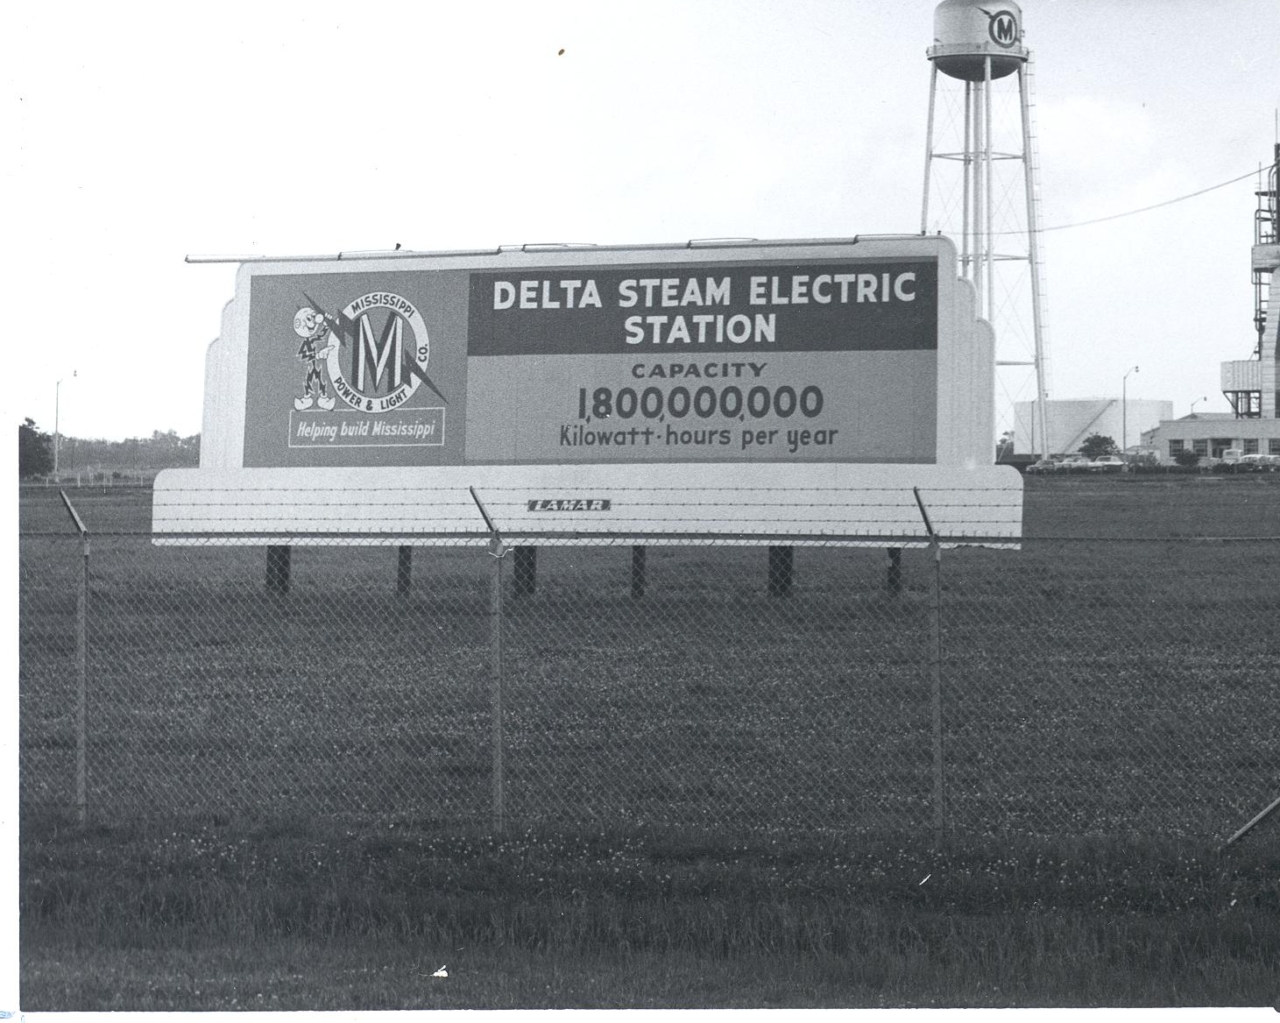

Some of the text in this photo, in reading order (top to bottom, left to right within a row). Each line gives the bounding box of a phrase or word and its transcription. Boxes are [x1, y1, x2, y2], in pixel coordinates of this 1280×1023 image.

[493, 272, 917, 310] DELTA STEAM ELECTRIC
[625, 313, 776, 344] STATION
[334, 294, 428, 411] MISSISSIPPI POWER & LIGHT CO.
[631, 362, 768, 379] CAPACITY
[578, 385, 824, 424] 1,800,000,000
[297, 420, 436, 441] Helping build Mississippi
[741, 427, 780, 450] per
[787, 428, 839, 453] year
[534, 500, 604, 511] LAMAR
